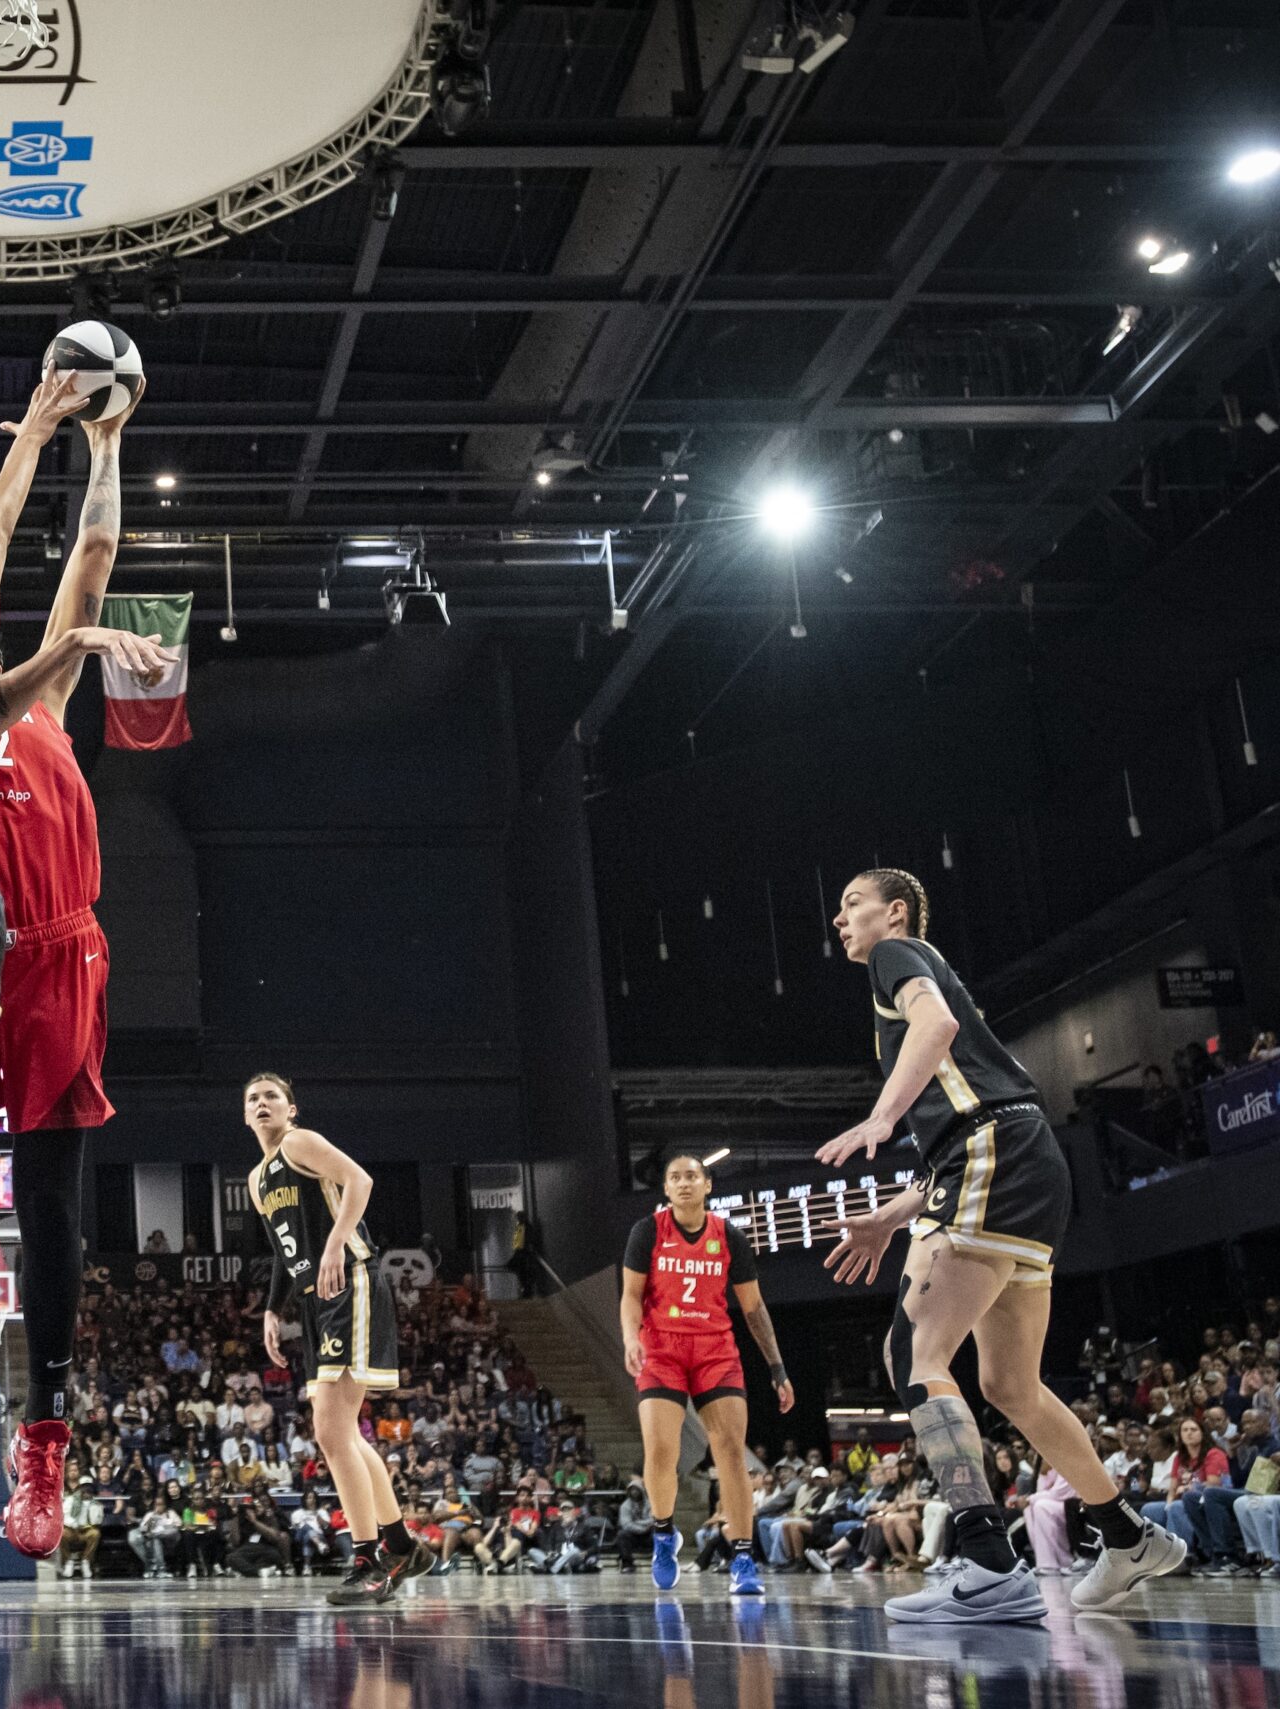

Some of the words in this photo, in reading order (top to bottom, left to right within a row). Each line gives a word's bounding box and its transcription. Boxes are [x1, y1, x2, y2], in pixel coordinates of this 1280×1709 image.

[7, 789, 31, 803] App
[225, 1185, 249, 1211] 111
[709, 1195, 743, 1210] PLAYER
[758, 1190, 776, 1203] PTS
[860, 1175, 878, 1189] STL
[275, 1221, 297, 1258] 5
[183, 1257, 214, 1283] GET
[221, 1257, 242, 1282] UP
[657, 1256, 723, 1276] ATLANTA
[682, 1277, 697, 1303] 2
